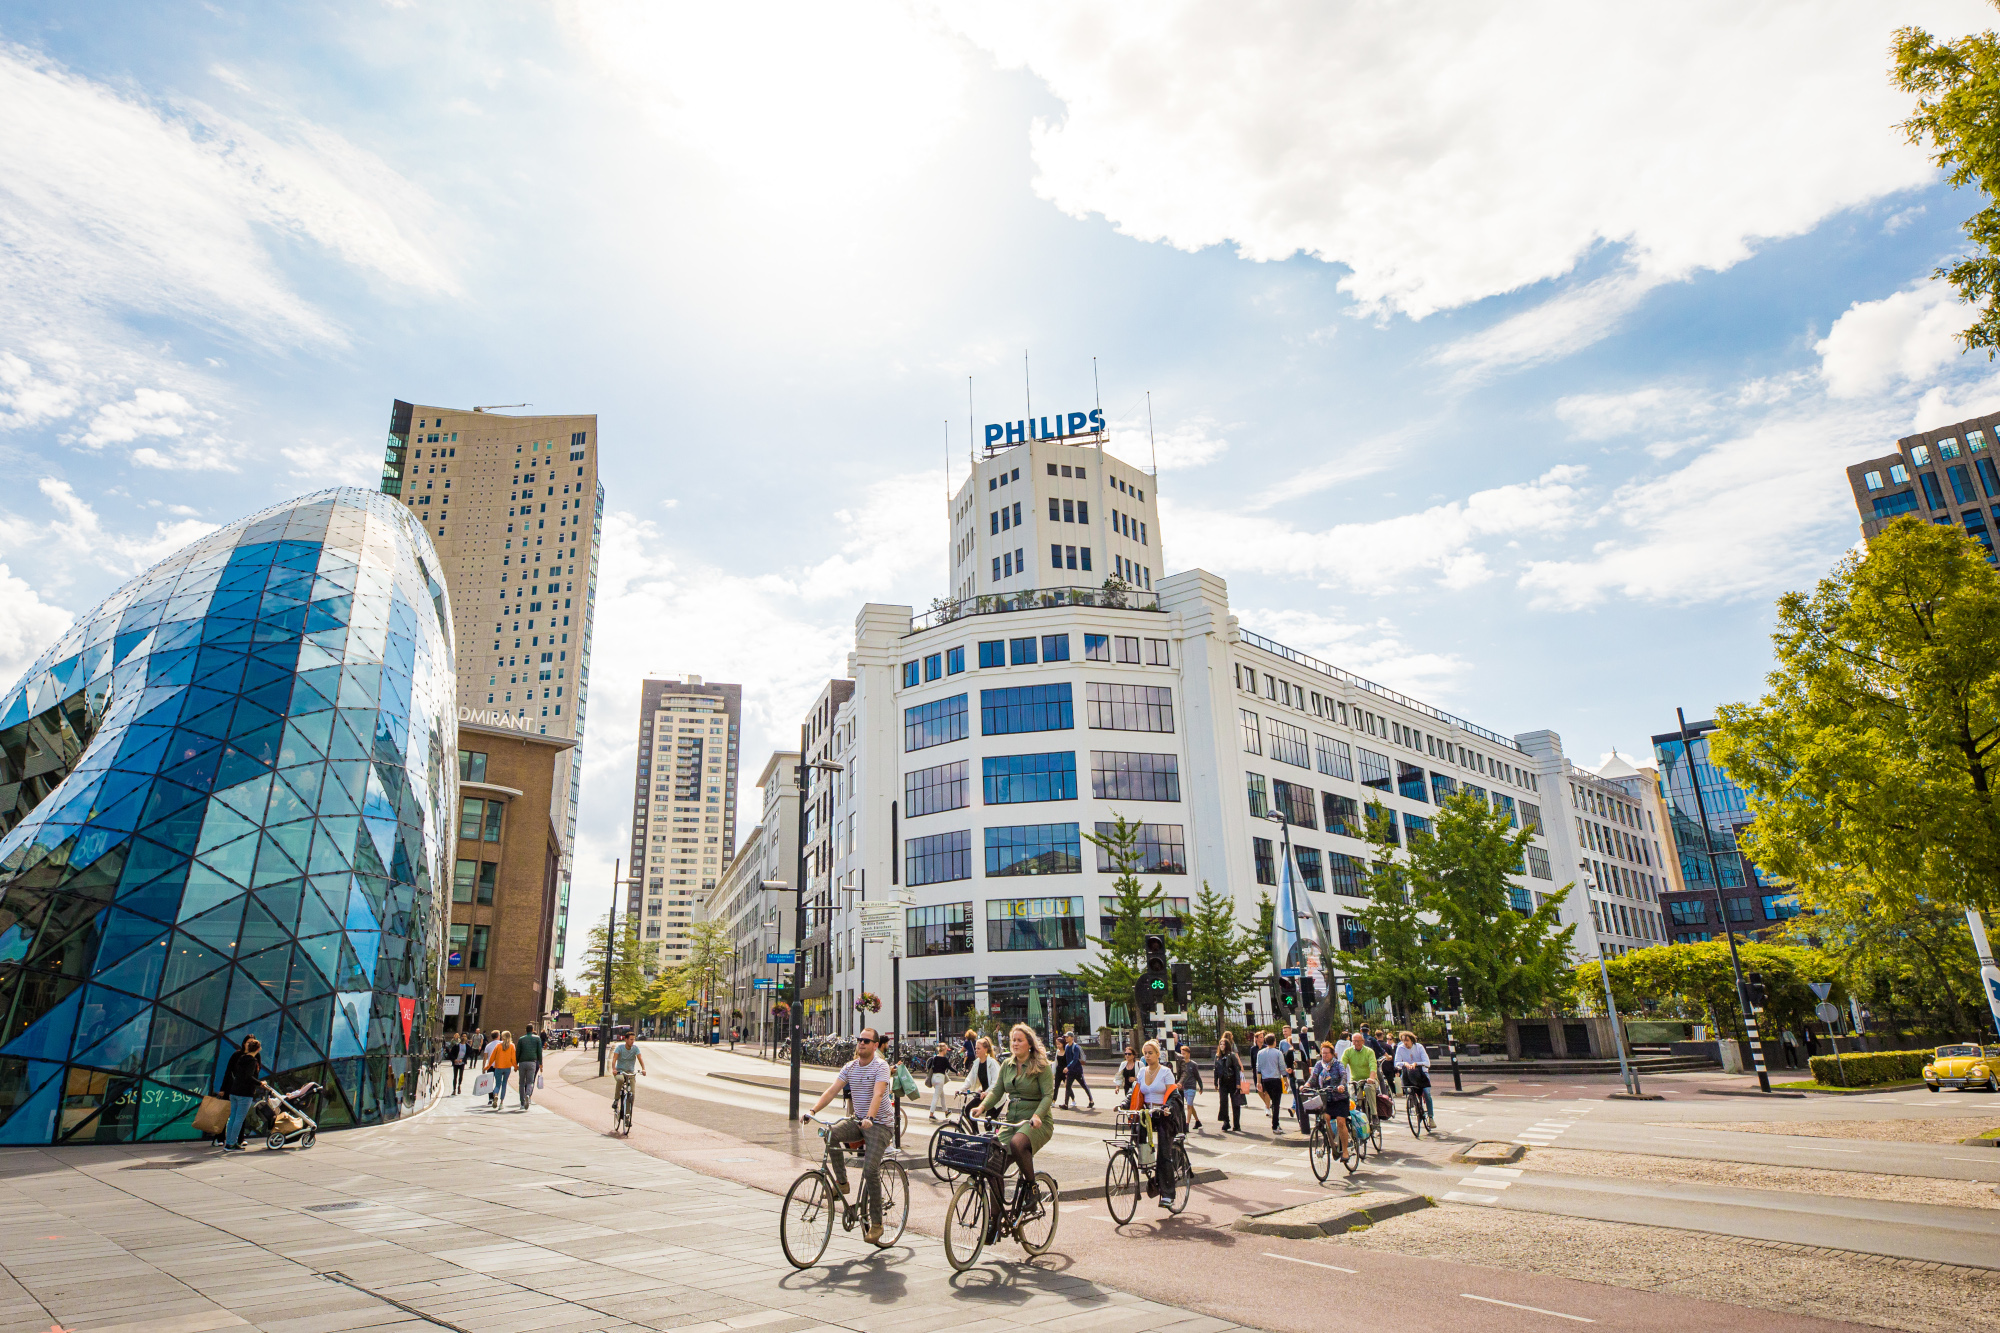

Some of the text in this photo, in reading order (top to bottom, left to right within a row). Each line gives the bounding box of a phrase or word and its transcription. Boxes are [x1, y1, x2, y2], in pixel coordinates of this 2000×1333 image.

[985, 408, 1106, 447] PHILIPS
[1007, 900, 1069, 916] IGLUU
[964, 905, 974, 949] MEETINGS
[403, 1007, 411, 1021] SALE
